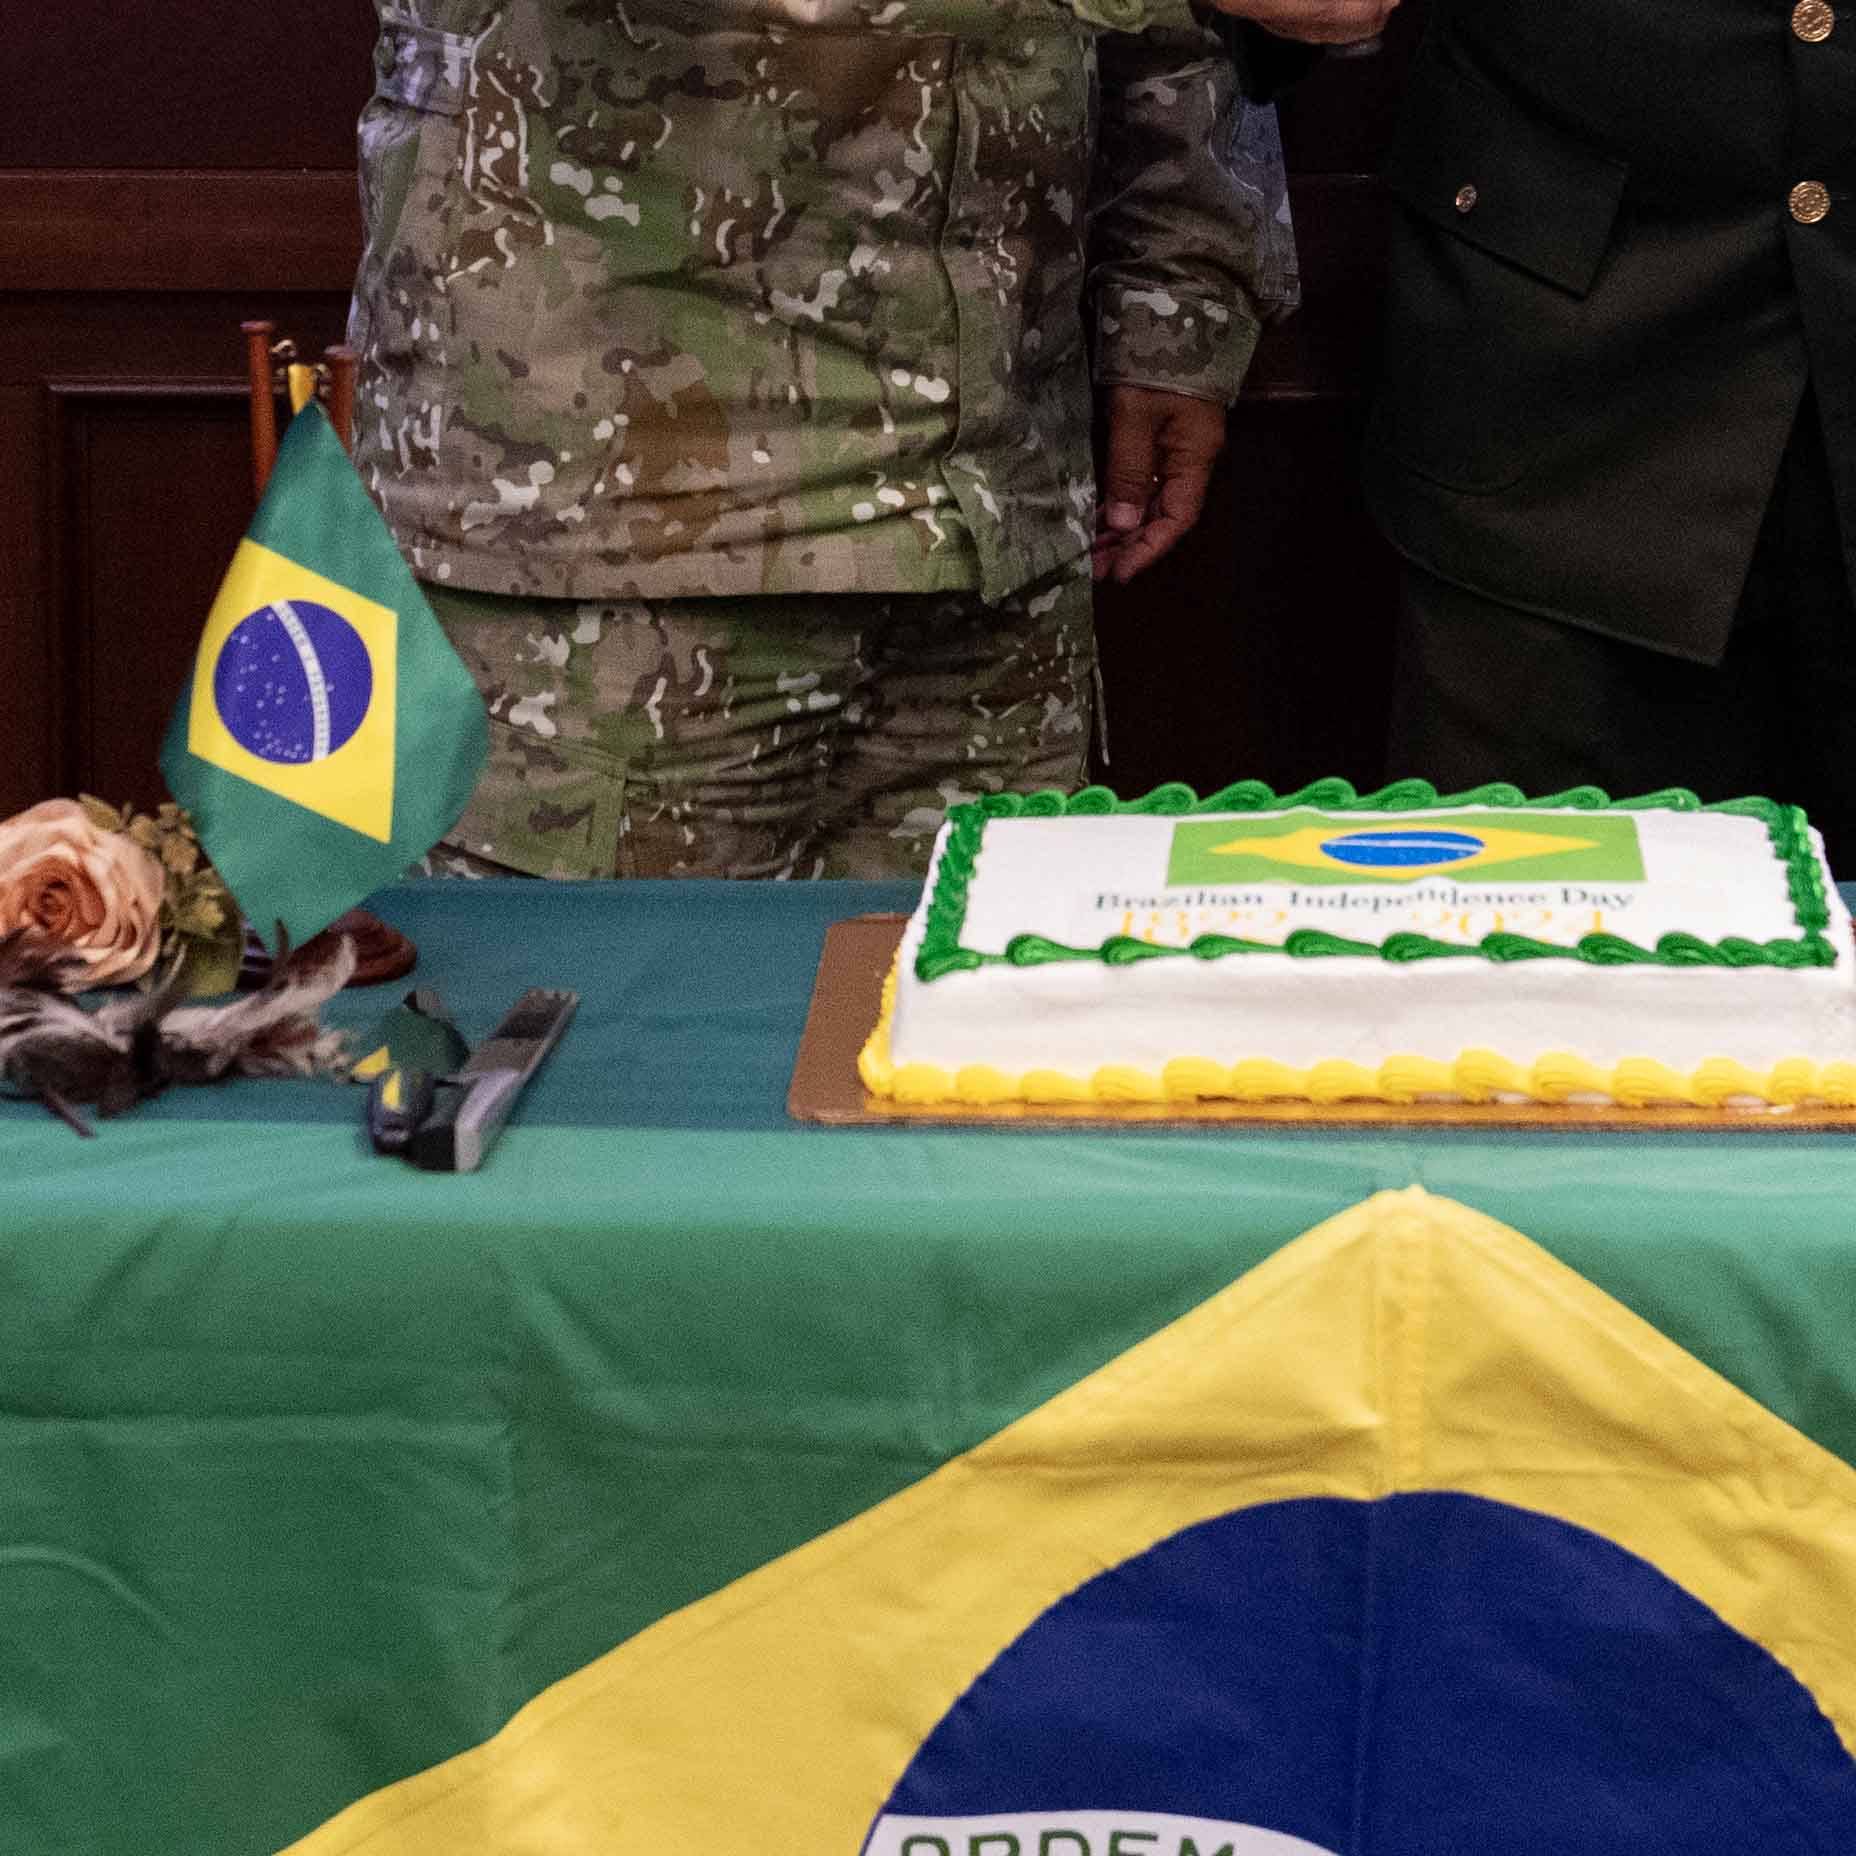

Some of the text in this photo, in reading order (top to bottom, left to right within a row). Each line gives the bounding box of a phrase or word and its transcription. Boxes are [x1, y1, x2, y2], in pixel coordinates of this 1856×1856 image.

[1096, 886, 1632, 912] Brazilian Independence Day
